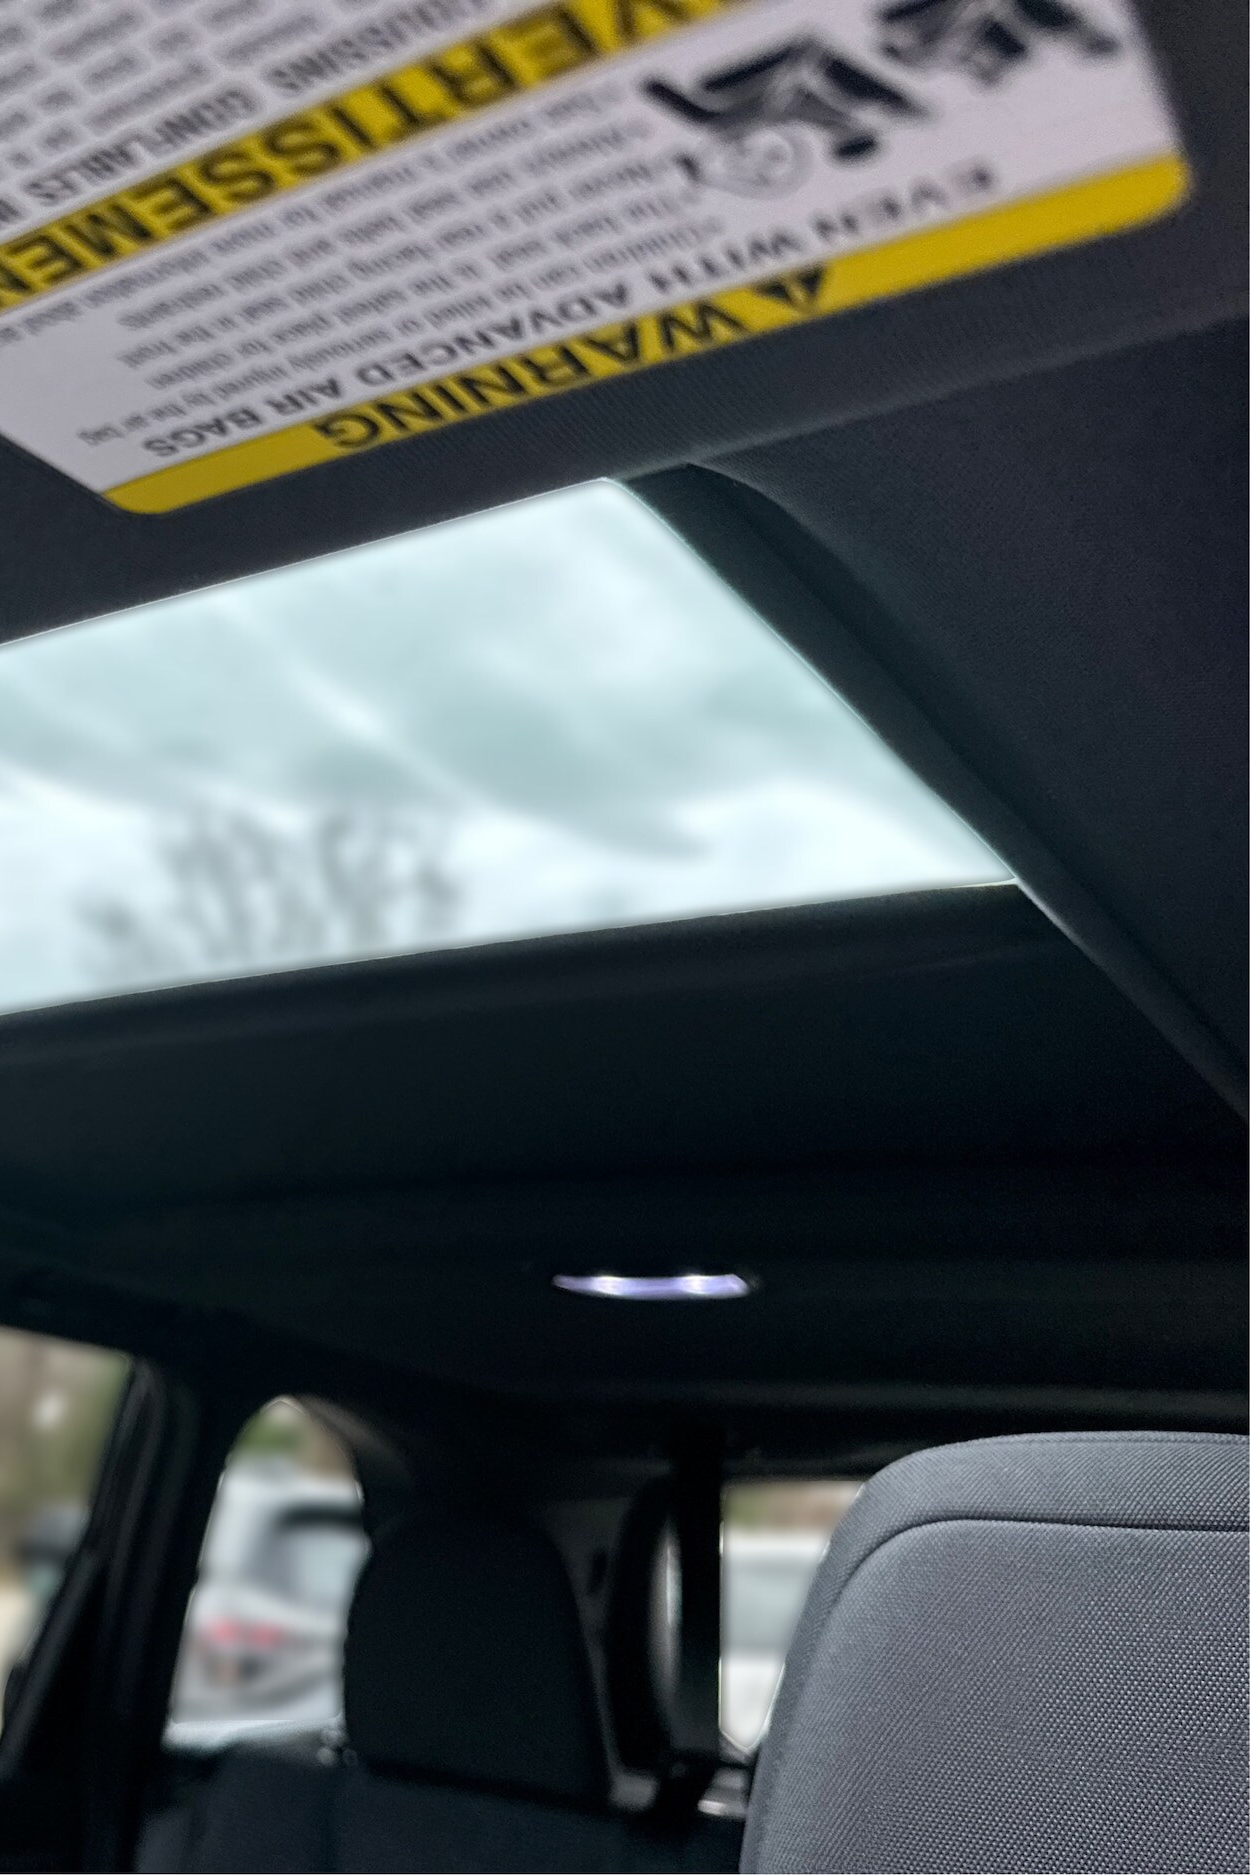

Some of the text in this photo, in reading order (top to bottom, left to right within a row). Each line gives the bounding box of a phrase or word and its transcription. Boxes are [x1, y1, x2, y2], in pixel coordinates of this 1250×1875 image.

[22, 87, 259, 206] GONFLABLES
[408, 273, 454, 296] the
[118, 283, 225, 330] restraints
[143, 164, 994, 456] EVEN WITH ADVANCED AIR BAGS
[332, 288, 407, 325] safest
[424, 294, 492, 329] killed
[173, 325, 216, 346] the
[269, 313, 333, 345] place
[395, 317, 424, 336] or
[236, 339, 273, 358] for
[281, 327, 393, 372] seriously
[147, 352, 233, 389] children
[211, 365, 288, 401] injured
[311, 300, 751, 449] WARNING
[146, 402, 187, 421] the
[182, 390, 217, 408] by
